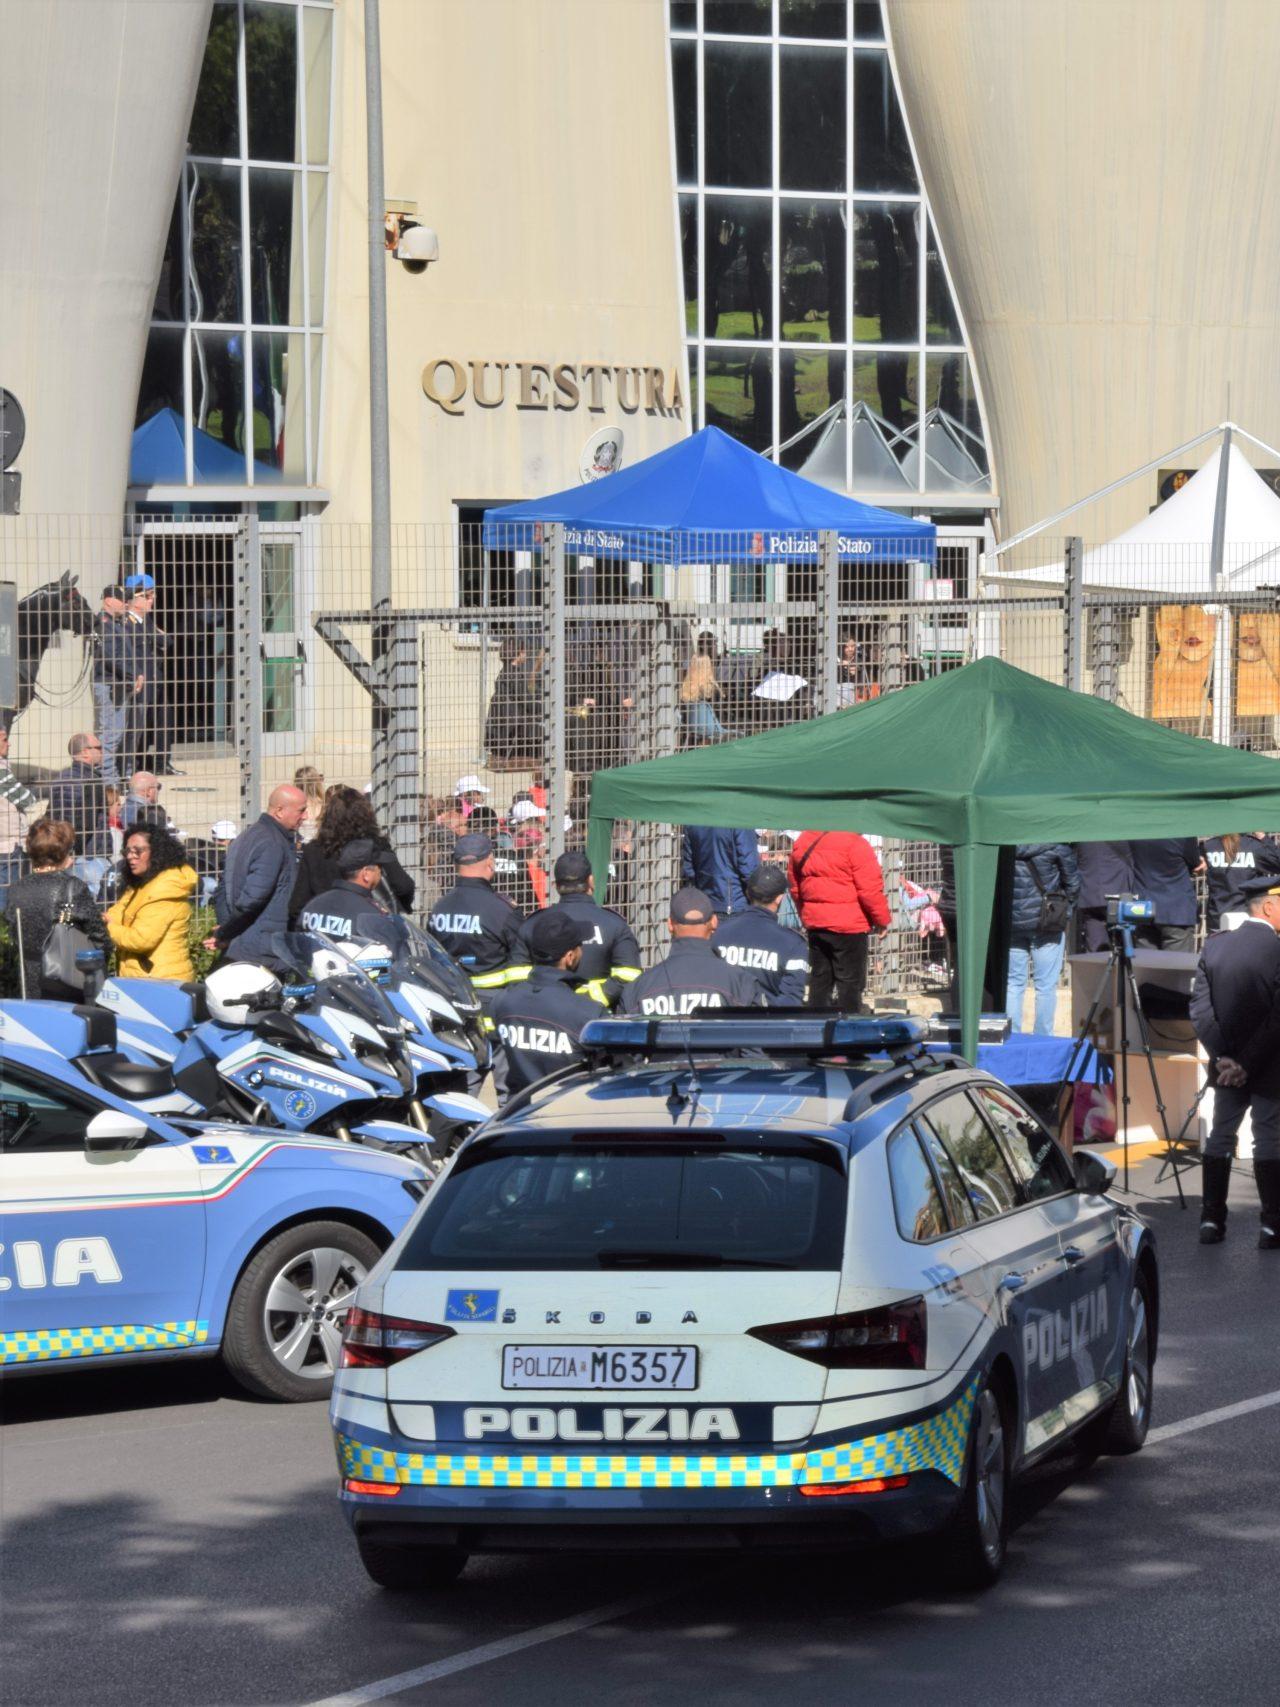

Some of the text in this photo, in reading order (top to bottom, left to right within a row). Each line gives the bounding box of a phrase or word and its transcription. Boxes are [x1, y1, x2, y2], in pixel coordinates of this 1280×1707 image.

[421, 359, 684, 418] QUESTURA
[770, 536, 871, 554] Polizia Stato
[302, 911, 352, 940] POLIZIA
[498, 1023, 573, 1055] POLIZIA
[269, 1066, 348, 1099] POLIZIA
[1022, 1283, 1109, 1371] POLIZIA
[512, 1351, 687, 1384] POLIZIA M6357
[464, 1407, 740, 1441] POLIZIA
